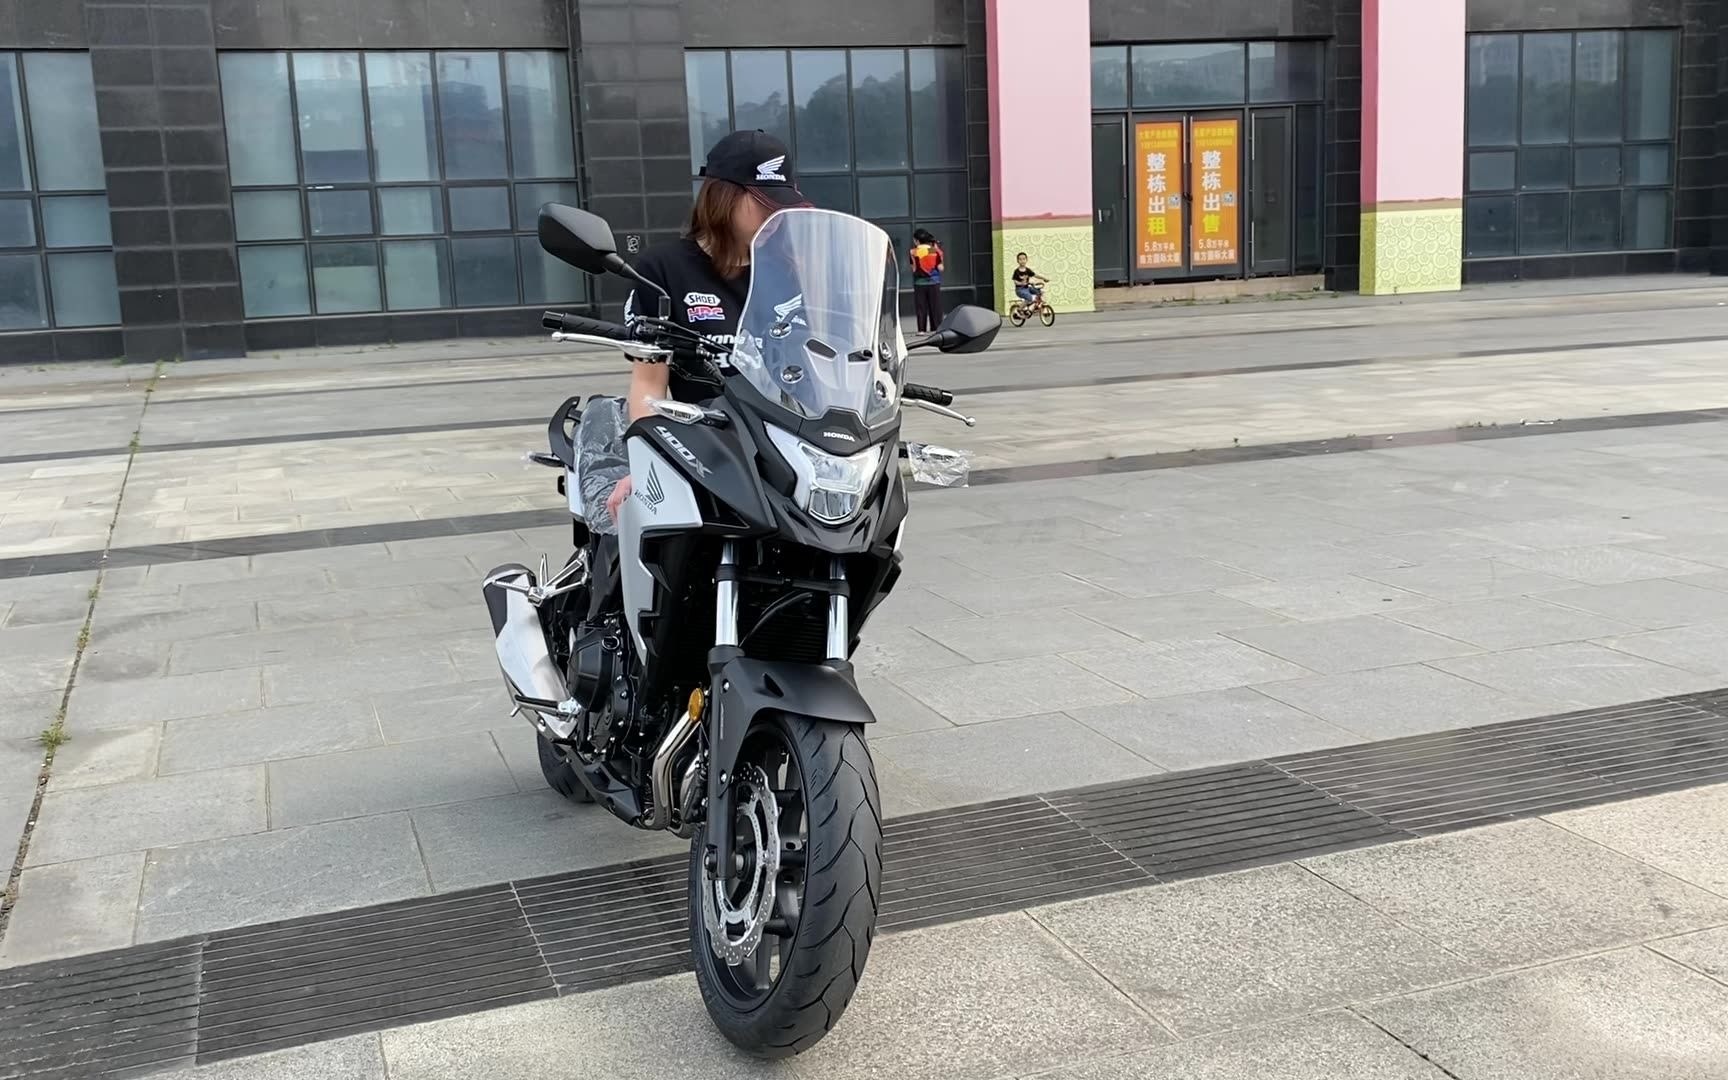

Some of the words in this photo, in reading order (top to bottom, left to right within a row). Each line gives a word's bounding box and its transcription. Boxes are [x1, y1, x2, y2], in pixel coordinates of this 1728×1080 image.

[755, 174, 787, 182] HONDA
[1146, 152, 1167, 235] 整栋出租
[1201, 150, 1221, 233] 整栋出售
[688, 293, 717, 304] SHOEI
[687, 306, 726, 322] HRC
[823, 431, 856, 442] HONDA
[653, 425, 713, 478] 400X
[634, 488, 657, 516] HONDA
